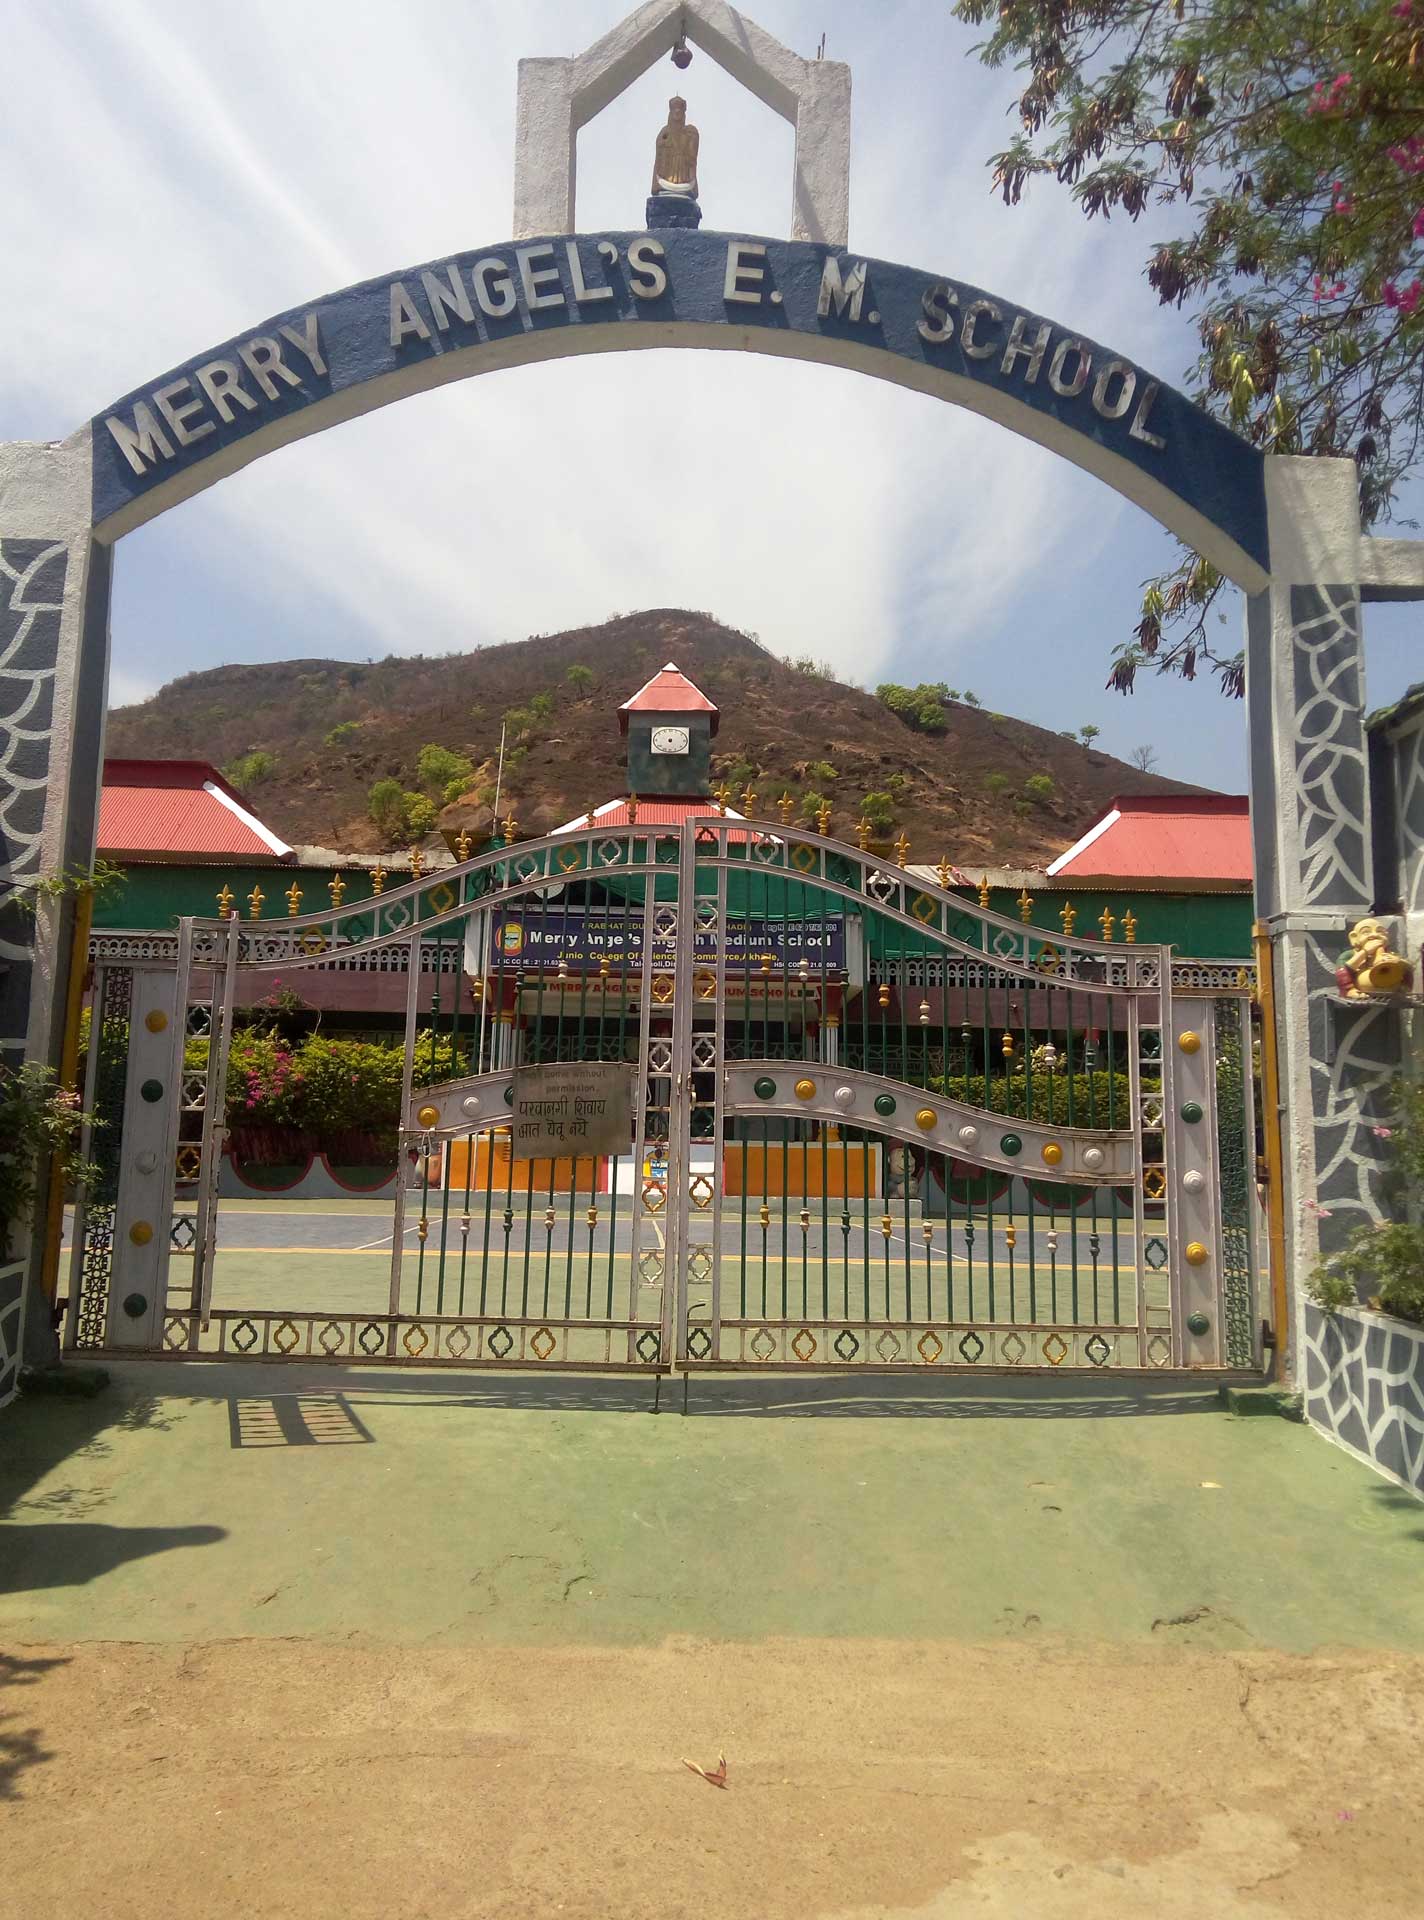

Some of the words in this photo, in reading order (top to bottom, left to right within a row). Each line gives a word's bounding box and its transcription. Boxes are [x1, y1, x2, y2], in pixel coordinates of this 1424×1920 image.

[105, 312, 331, 476] MERRY
[389, 237, 667, 347] ANGEL'S
[723, 242, 783, 304] E.
[816, 256, 881, 325] M.
[915, 284, 1167, 450] SCHOOL
[581, 932, 641, 948] Ange's
